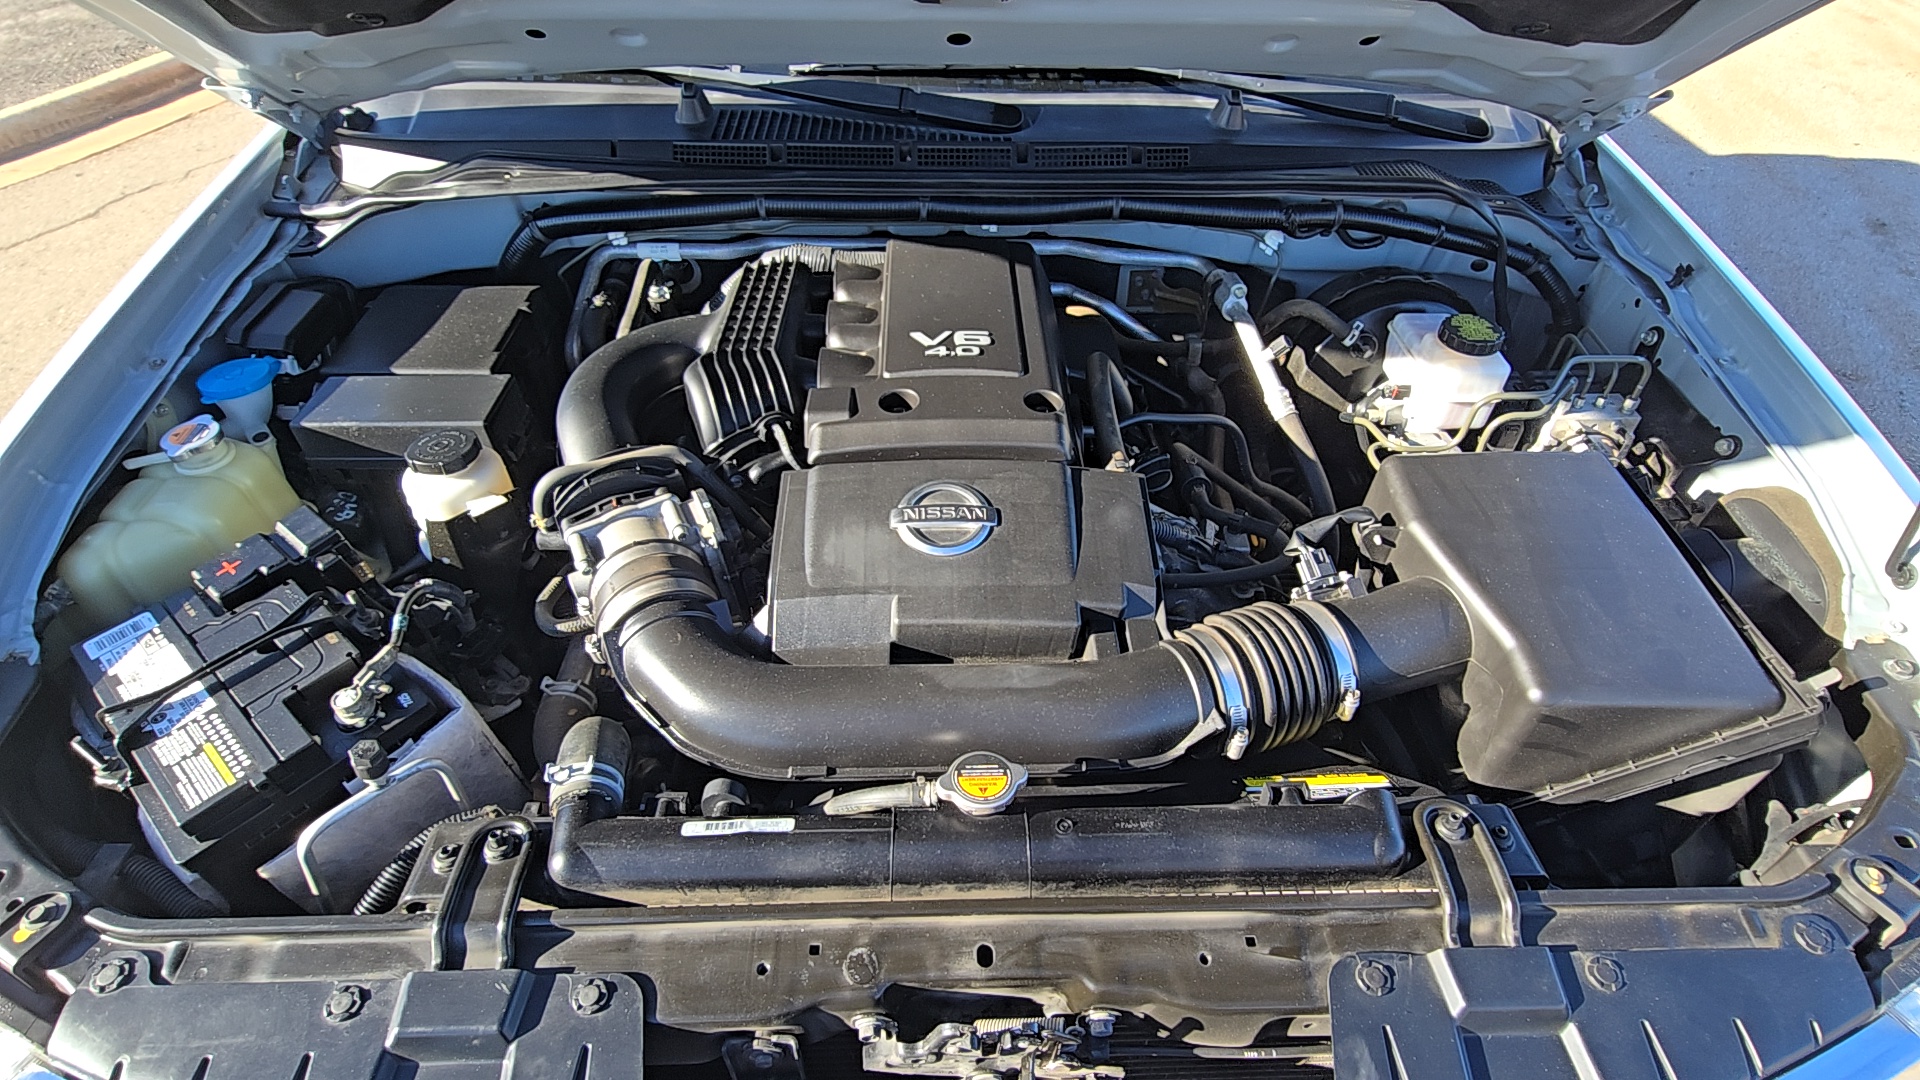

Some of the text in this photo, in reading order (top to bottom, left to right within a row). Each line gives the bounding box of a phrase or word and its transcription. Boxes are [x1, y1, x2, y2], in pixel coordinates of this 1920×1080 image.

[909, 330, 992, 347] V6
[924, 345, 981, 357] 4.0
[902, 506, 987, 521] NISSAN
